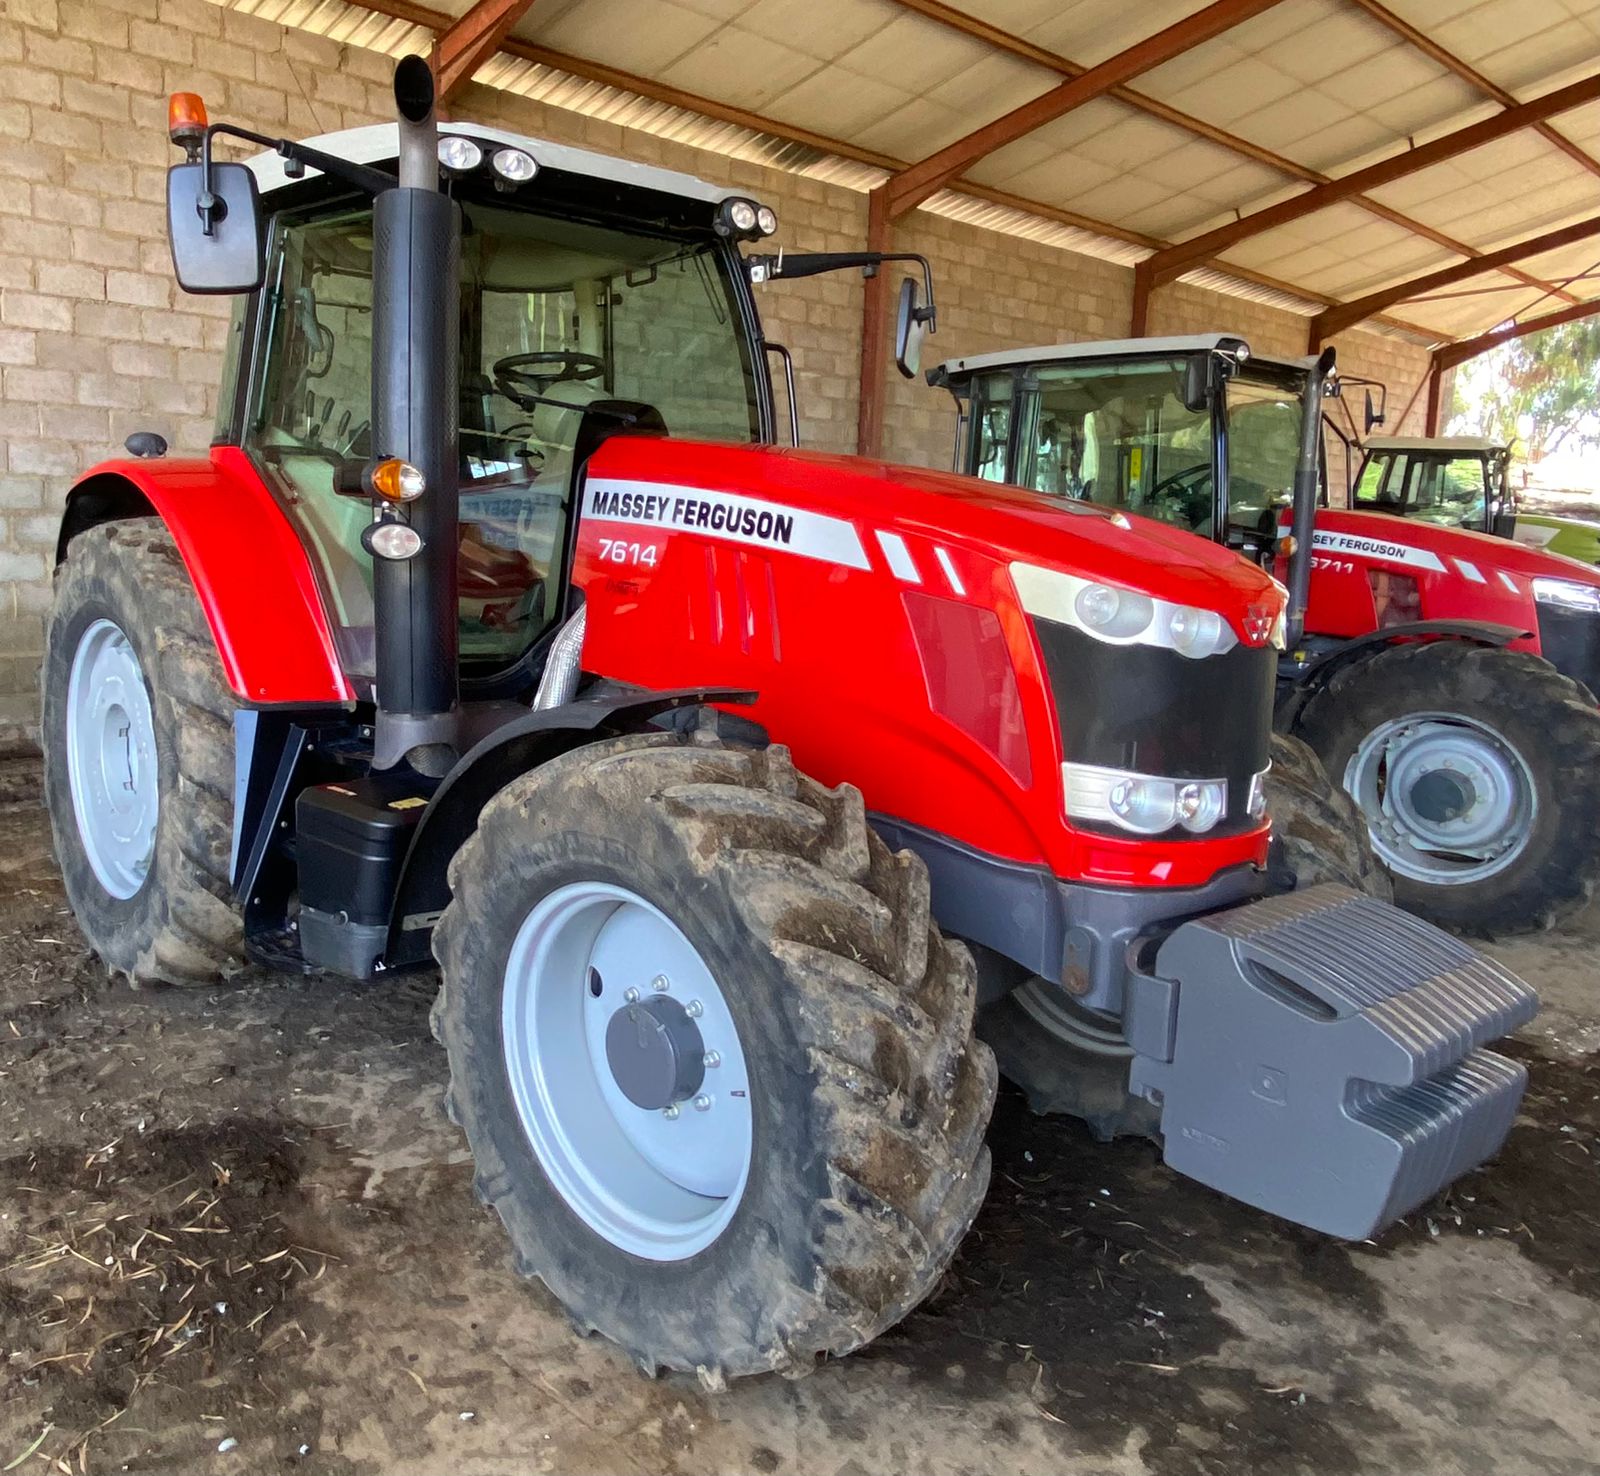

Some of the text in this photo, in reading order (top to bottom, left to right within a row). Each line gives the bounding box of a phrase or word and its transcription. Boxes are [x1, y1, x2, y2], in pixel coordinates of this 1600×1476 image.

[591, 491, 793, 543] MASSEY FERGUSON
[599, 539, 657, 567] 7614
[1312, 534, 1406, 558] SEY FERGUSON
